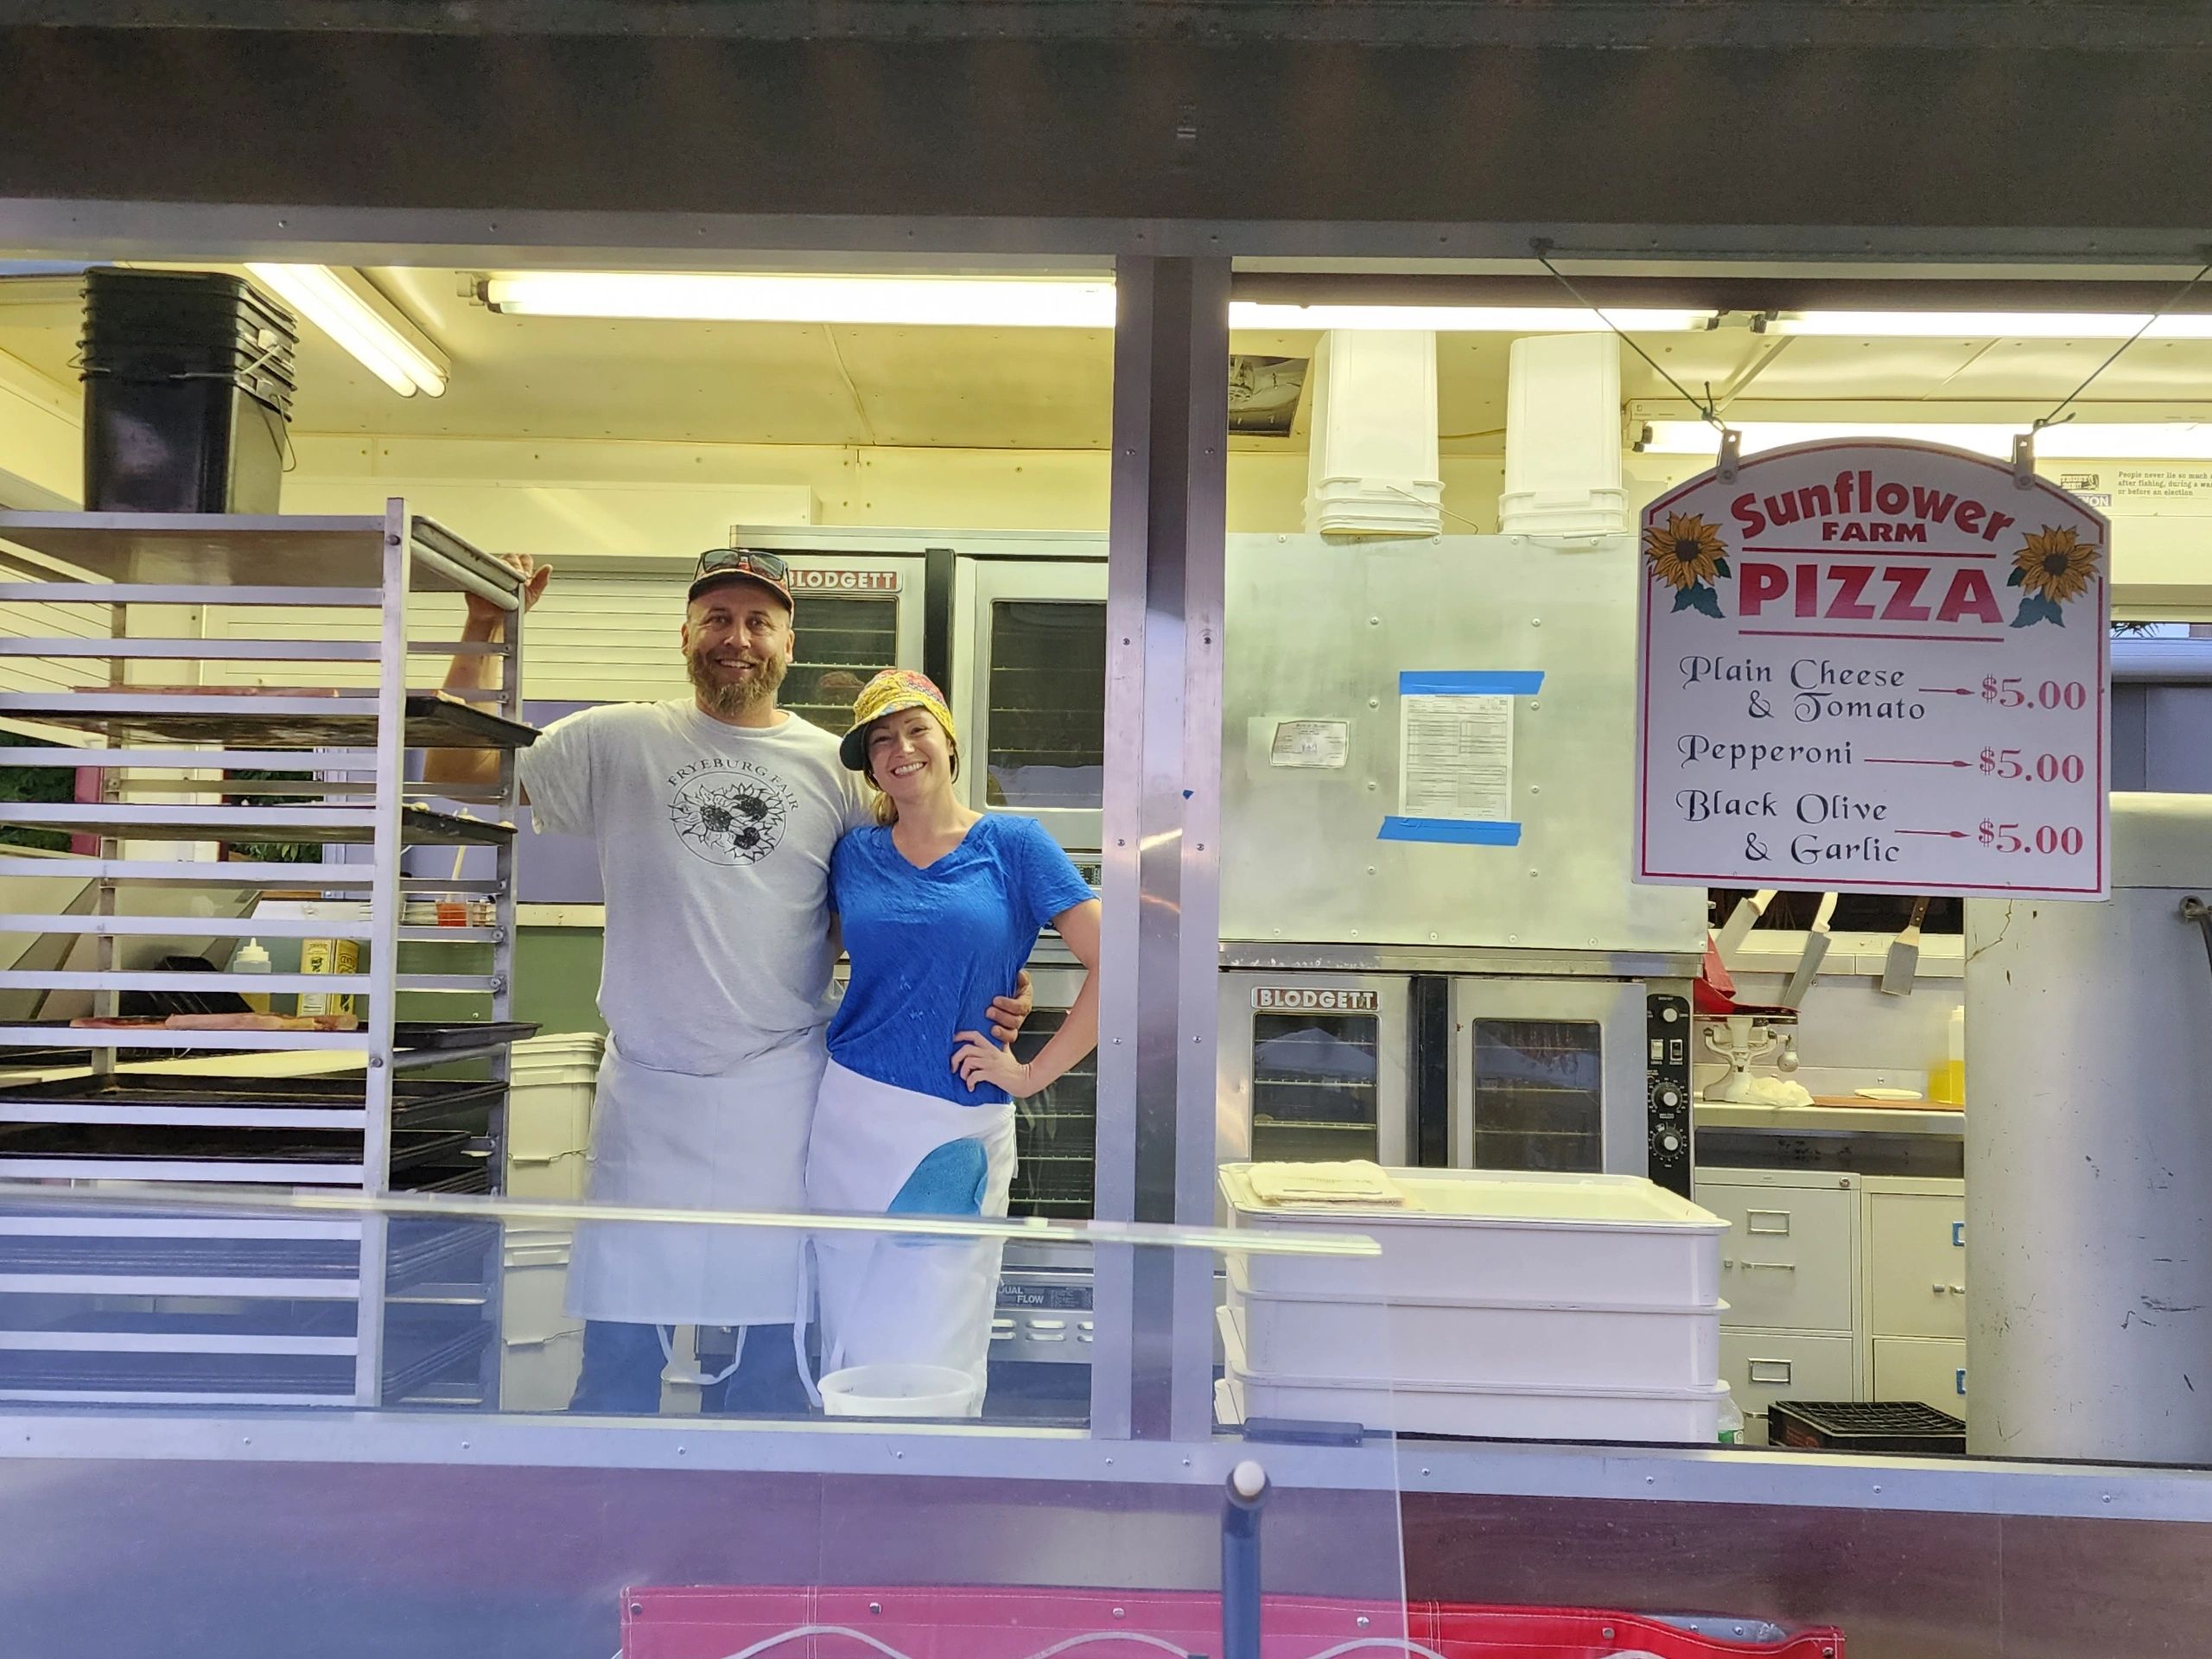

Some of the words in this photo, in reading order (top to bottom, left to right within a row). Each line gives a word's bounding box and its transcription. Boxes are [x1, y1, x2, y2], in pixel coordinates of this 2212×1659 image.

[1731, 470, 2016, 542] Sunflower
[1822, 521, 1927, 543] FARM
[1738, 563, 2005, 623] PIZZA
[1679, 656, 1772, 690] Plain
[1790, 659, 1905, 690] Cheese
[1748, 690, 1775, 718] &
[1793, 692, 1925, 722] Tomato
[1981, 673, 2086, 710] $5.00
[1677, 734, 1852, 771] Pepperoni
[1979, 746, 2084, 783] $5.00
[667, 758, 768, 787] FRYEBURG
[771, 774, 799, 812] FAIR
[1675, 790, 1777, 822] Black
[1796, 793, 1887, 824] Olive
[1745, 832, 1773, 861] &
[1791, 834, 1900, 865] Garlic
[1978, 817, 2083, 855] $5.00
[1261, 989, 1374, 1009] BLODGETT
[1017, 1295, 1044, 1304] FLOW
